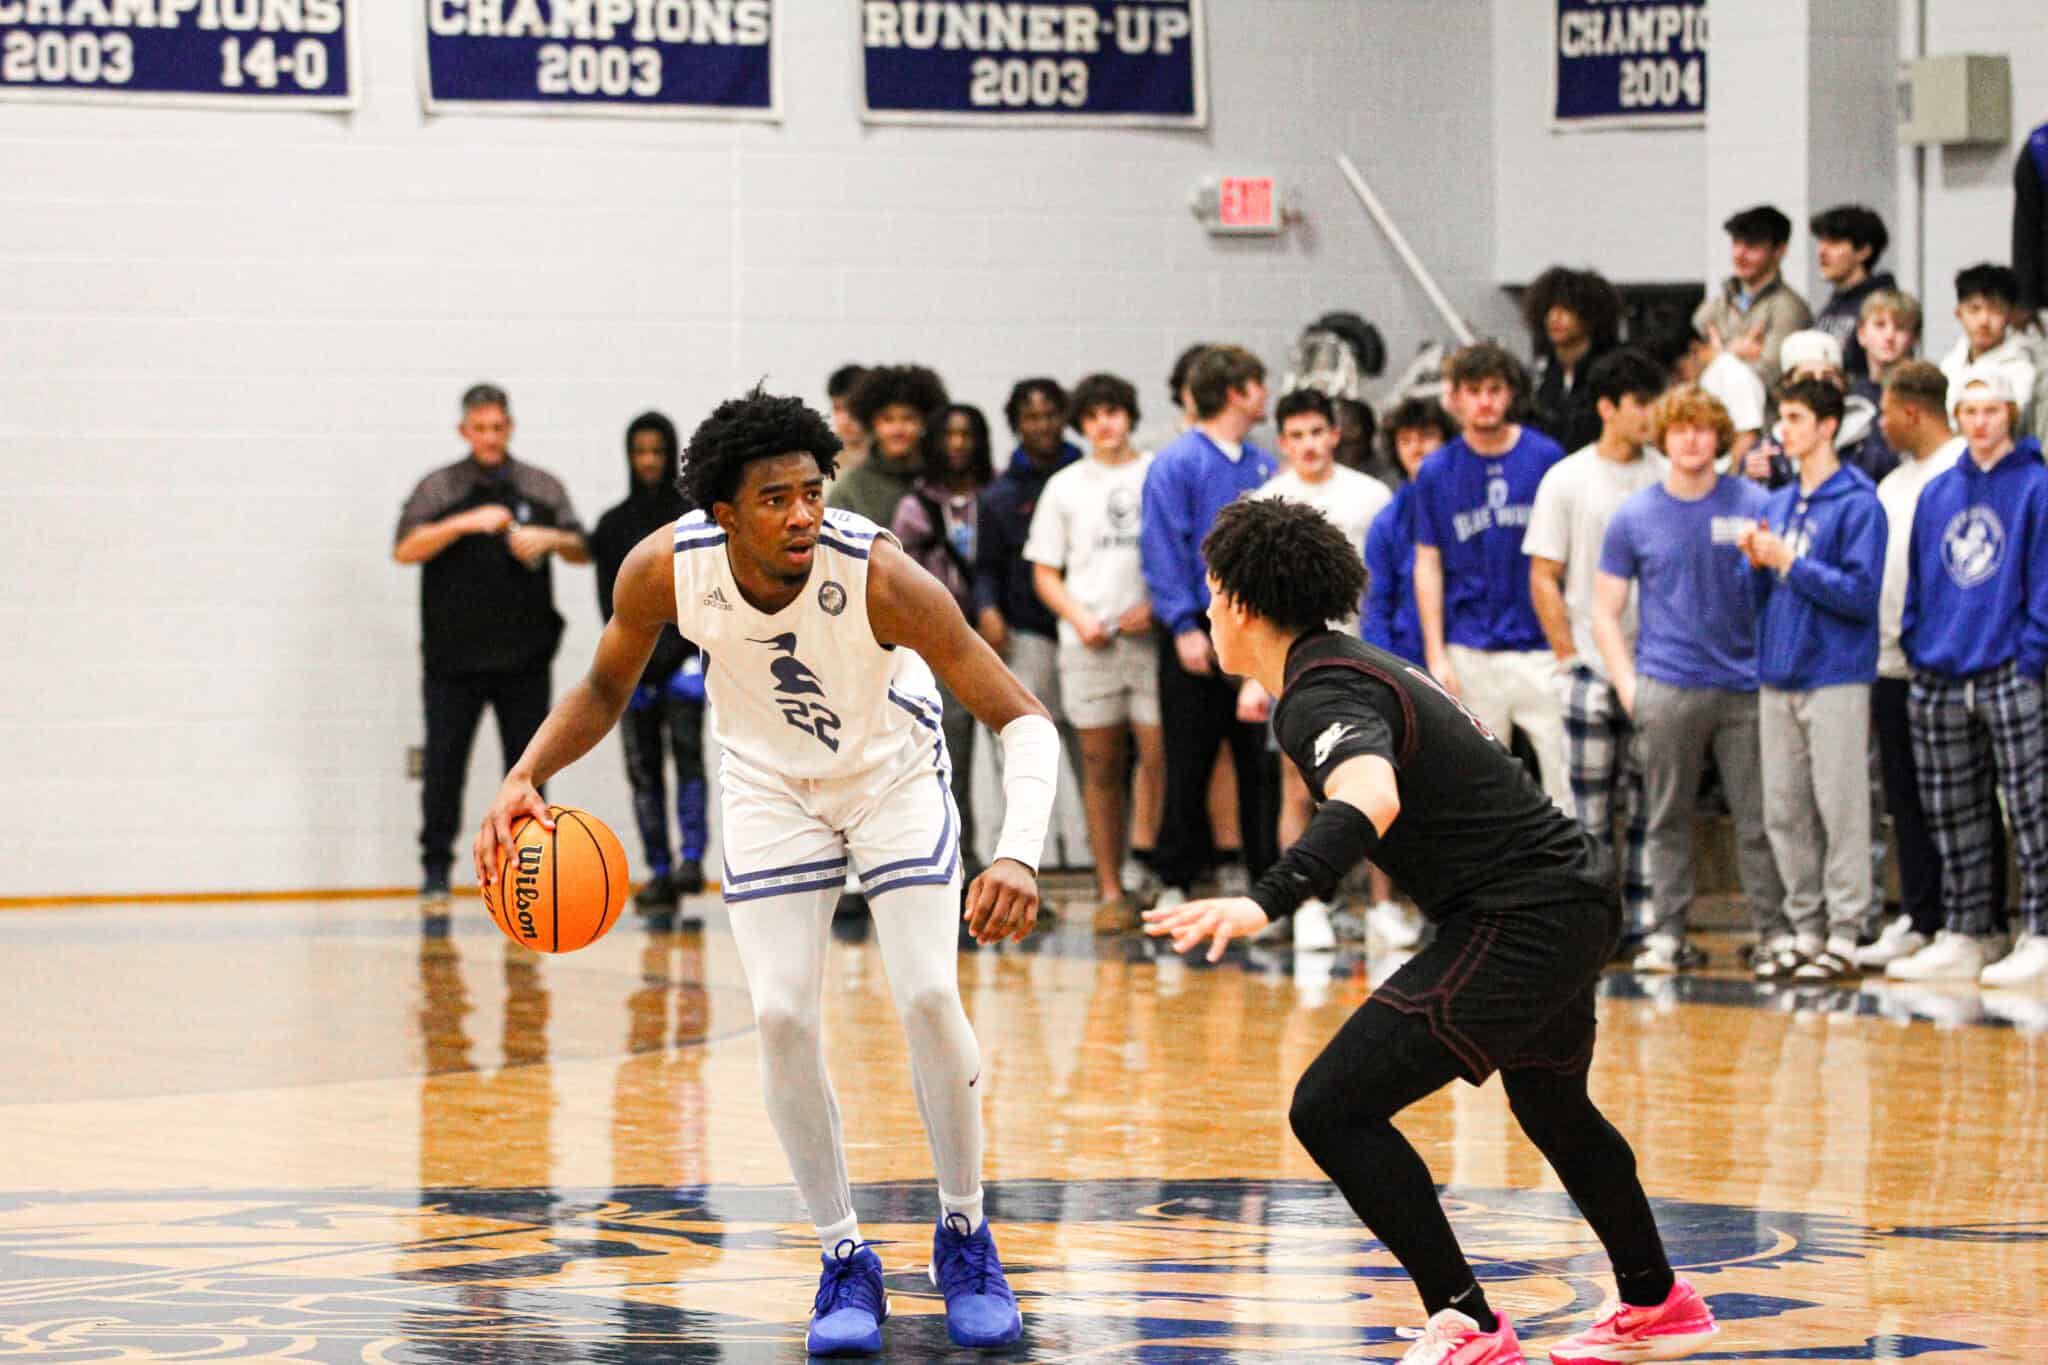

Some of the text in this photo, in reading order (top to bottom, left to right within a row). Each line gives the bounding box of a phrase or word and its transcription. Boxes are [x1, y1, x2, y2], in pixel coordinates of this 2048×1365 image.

[429, 0, 768, 45] CHAMPIONS
[863, 1, 1189, 53] RUNNER-UP
[3, 31, 329, 89] 2003 14-0
[537, 43, 662, 97] 2003
[970, 57, 1089, 107] 2003
[1619, 57, 1702, 107] 2004
[775, 698, 842, 754] 22
[515, 844, 544, 939] Wilson
